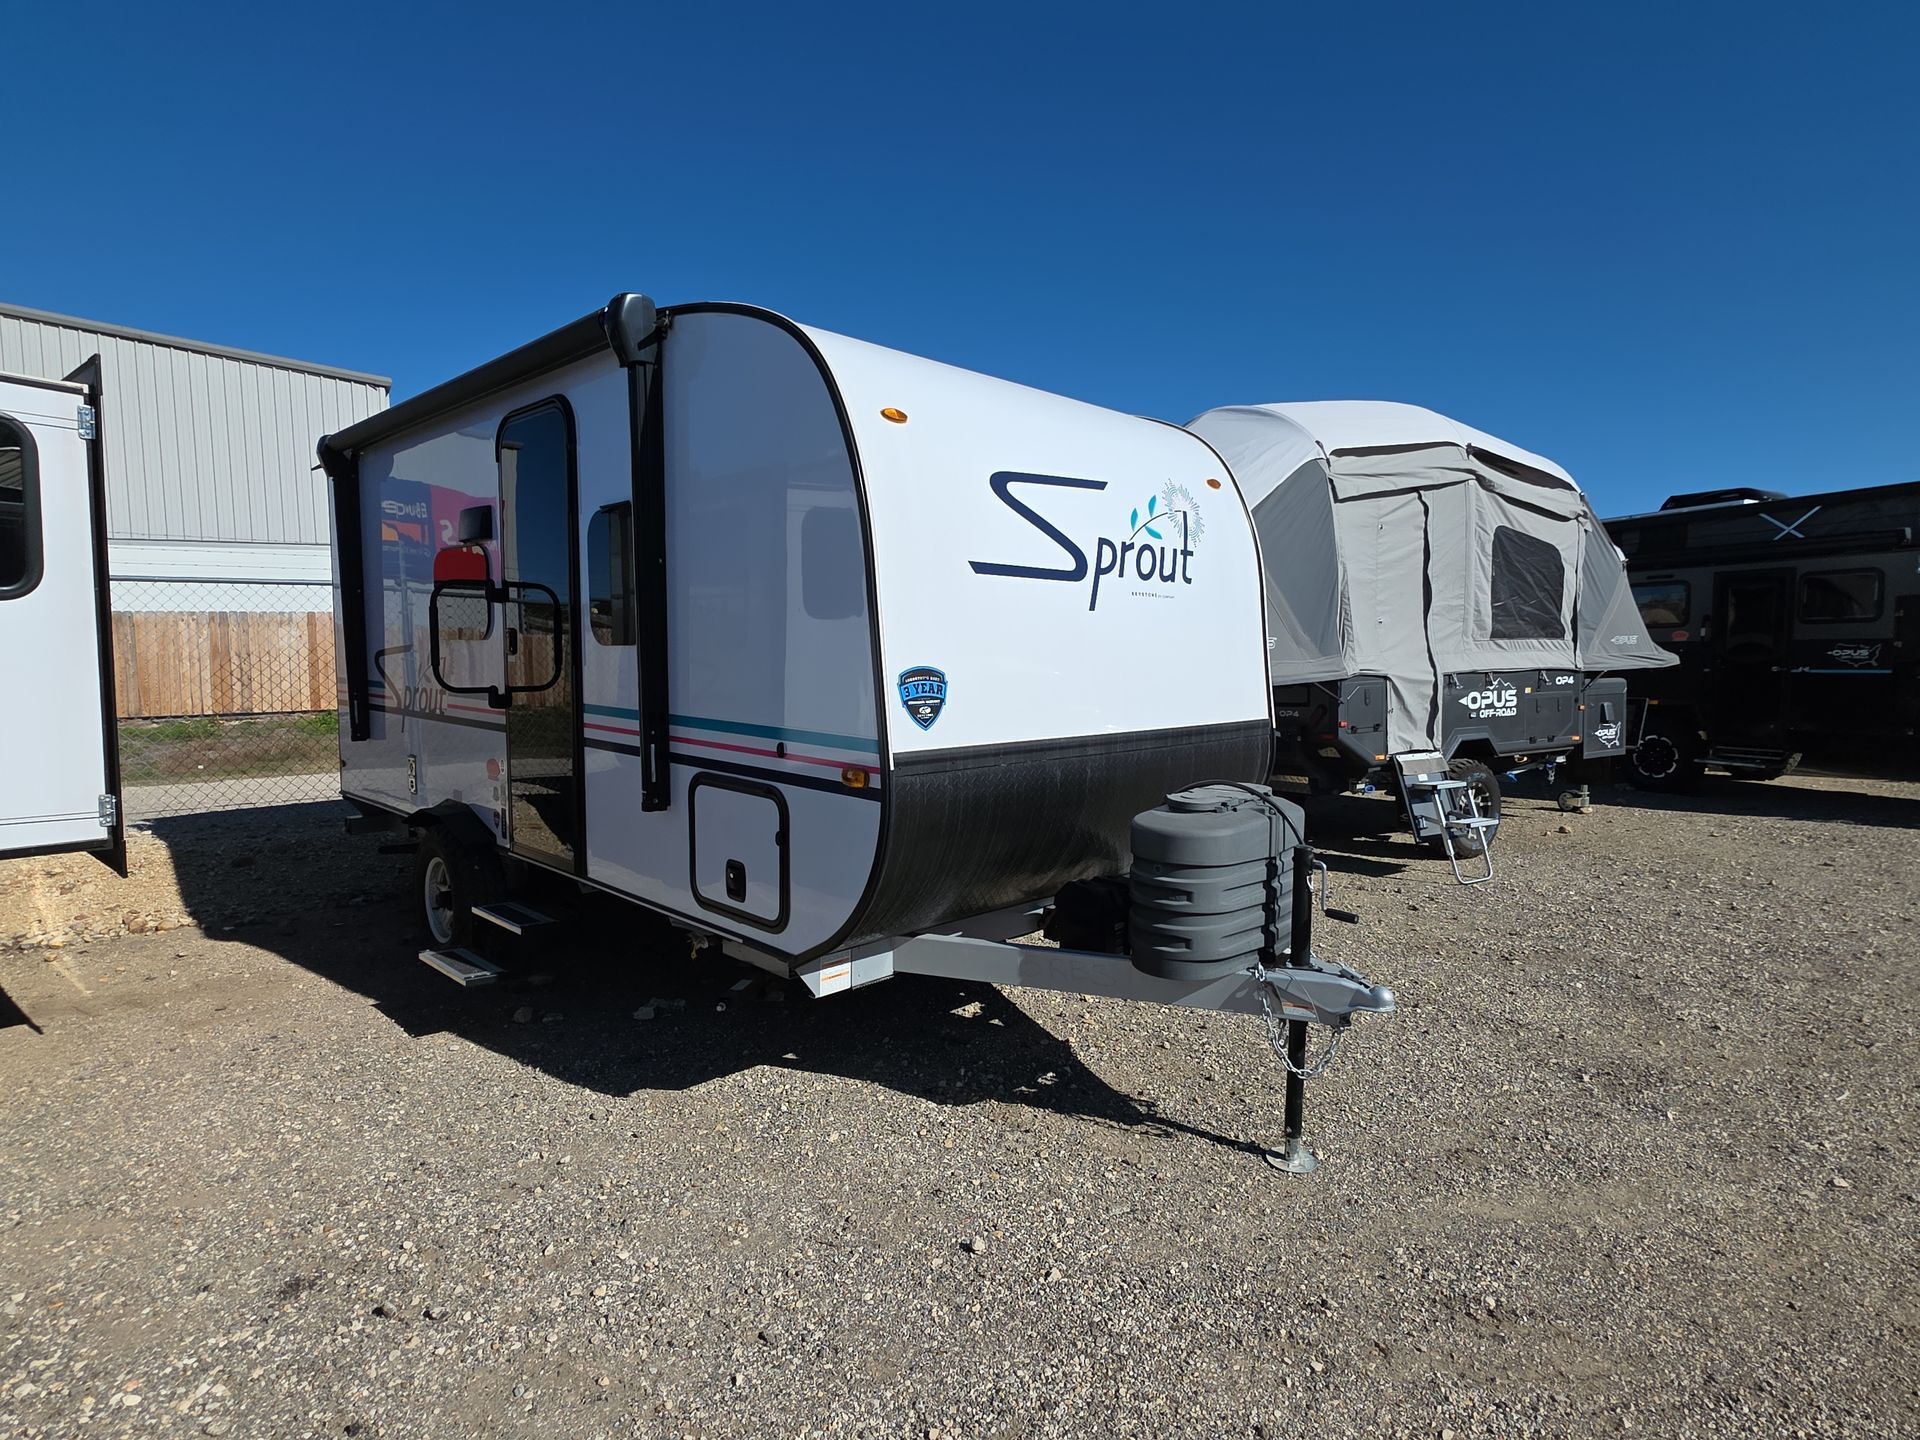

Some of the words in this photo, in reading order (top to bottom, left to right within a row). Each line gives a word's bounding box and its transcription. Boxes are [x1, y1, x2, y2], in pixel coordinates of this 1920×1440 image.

[968, 471, 1194, 611] Sprout
[375, 645, 447, 733] Sprout
[1555, 675, 1574, 686] OP4
[903, 687, 910, 698] 3
[913, 683, 943, 696] YEAR
[1467, 689, 1517, 710] OPUS
[1479, 707, 1517, 718] OFF-ROAD
